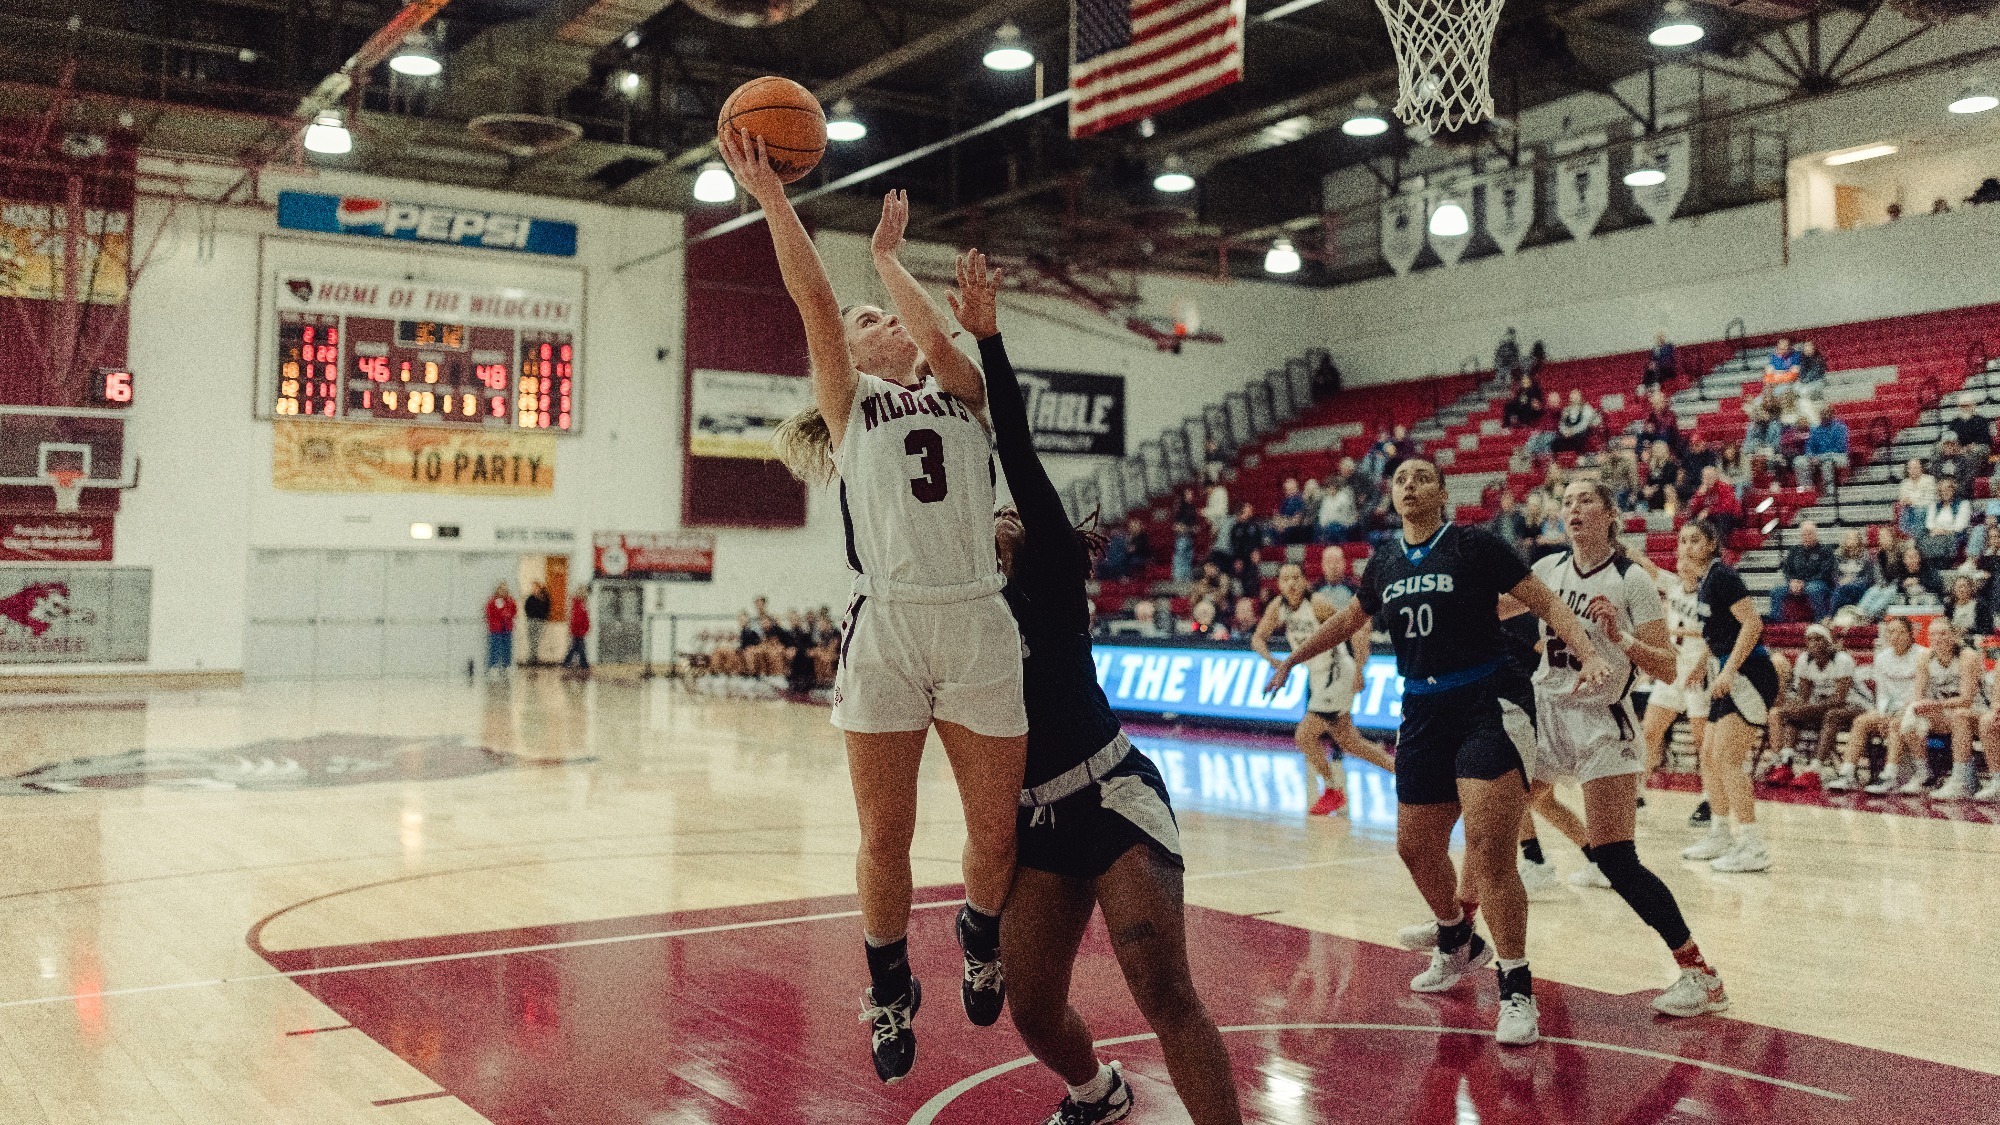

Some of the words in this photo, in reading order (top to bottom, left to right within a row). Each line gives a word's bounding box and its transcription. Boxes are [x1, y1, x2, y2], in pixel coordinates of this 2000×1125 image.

[383, 203, 531, 248] PEPSI
[317, 281, 380, 305] HOME
[388, 289, 416, 309] OF
[424, 290, 460, 312] THE
[359, 356, 390, 382] 46
[477, 365, 506, 390] 48
[861, 391, 969, 432] WILDCATS
[1016, 373, 1113, 434] TABLE
[410, 450, 442, 483] TO
[453, 453, 542, 484] PARTY
[904, 429, 948, 503] 3
[1382, 573, 1454, 604] CSUSB
[1399, 603, 1433, 638] 20
[1117, 654, 1193, 702] THE
